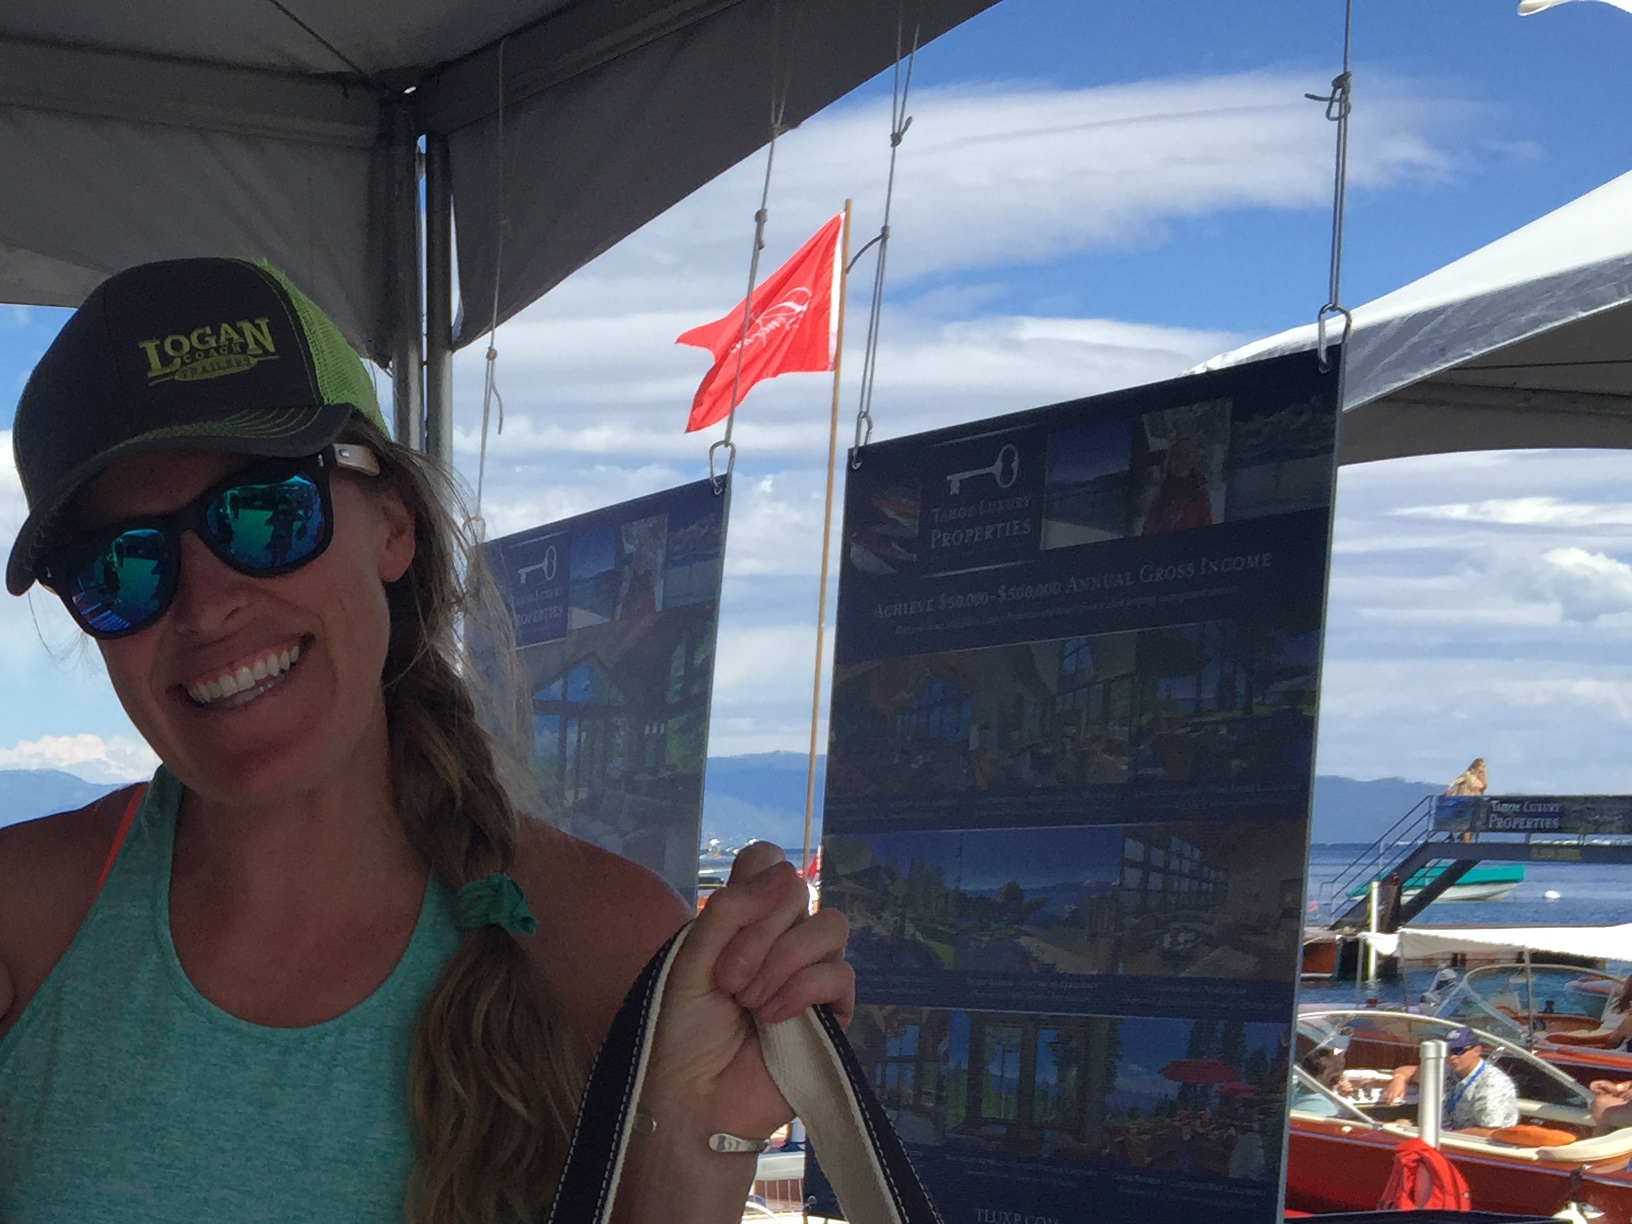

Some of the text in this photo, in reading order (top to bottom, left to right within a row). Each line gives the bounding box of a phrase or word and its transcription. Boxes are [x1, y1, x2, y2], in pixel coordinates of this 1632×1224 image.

[138, 316, 277, 378] LOGAN
[981, 495, 1032, 517] LUXURY
[930, 518, 1032, 550] PROPERTIES
[875, 598, 935, 620] ACHIEVE
[1065, 572, 1135, 594] ANNUAL
[1139, 563, 1196, 584] GROSS
[1199, 552, 1273, 577] INCOME
[1489, 813, 1560, 829] PROPERTIES
